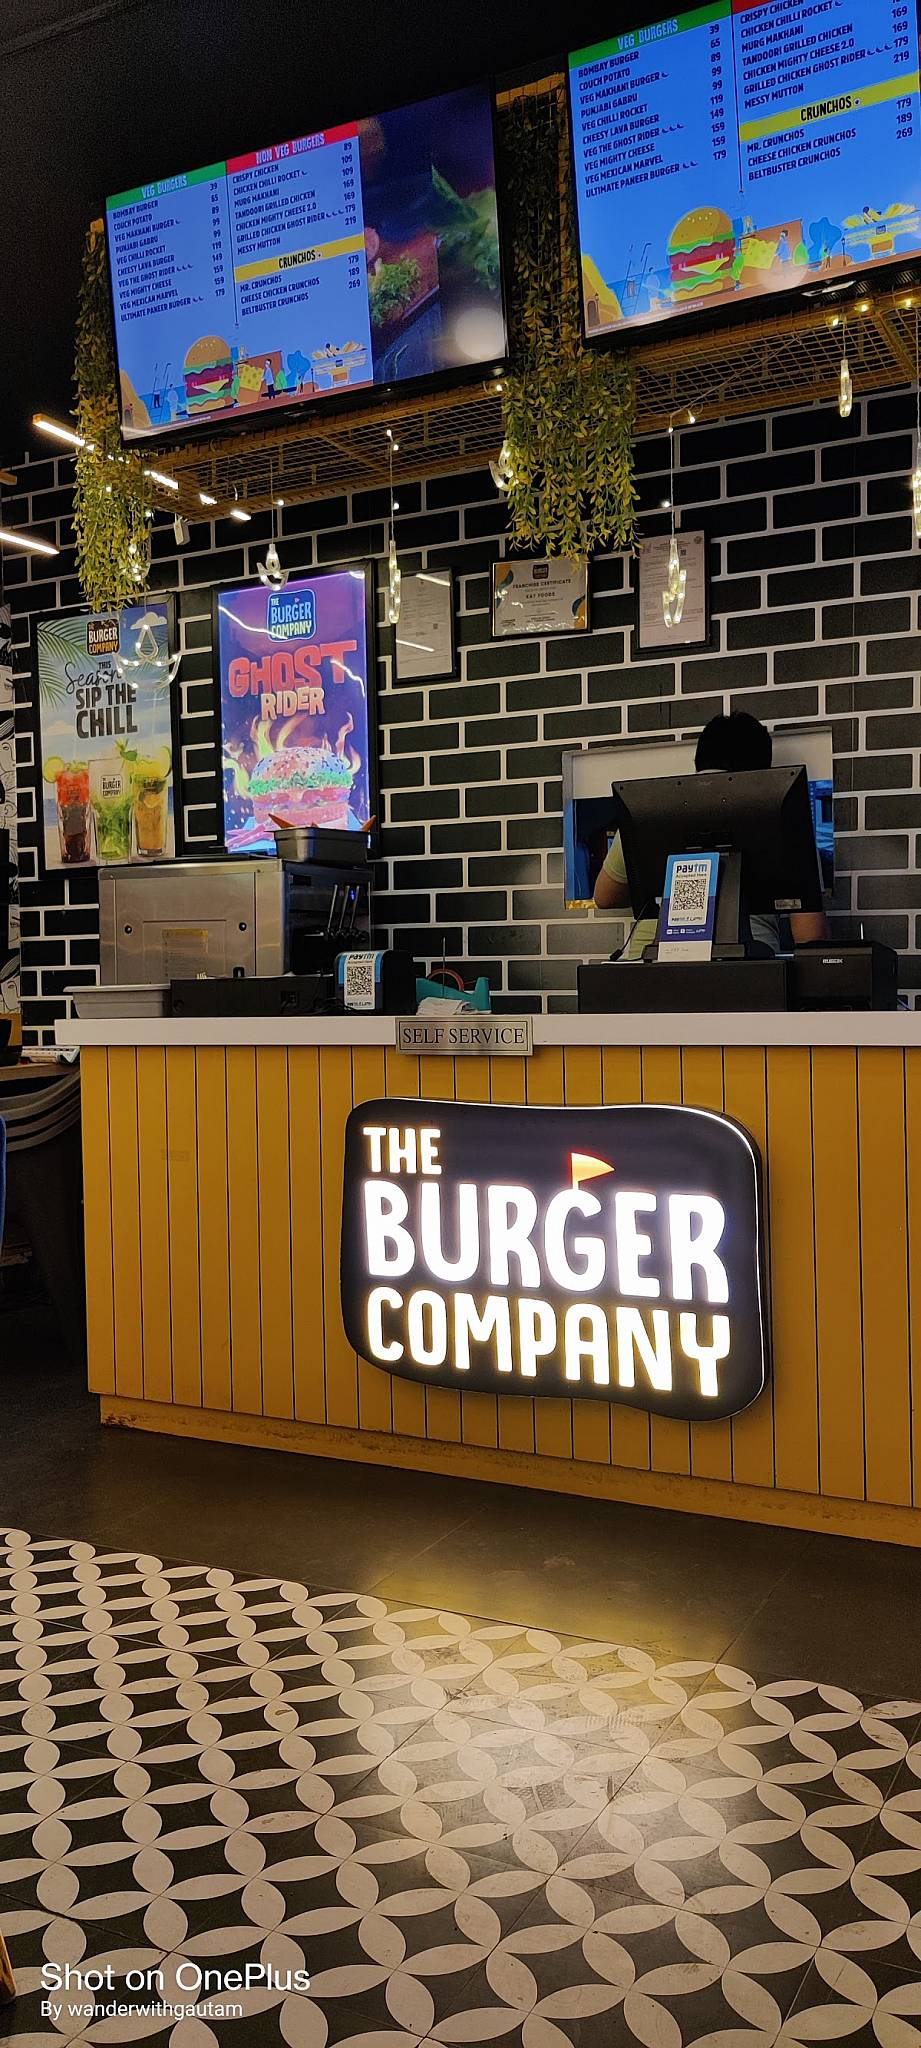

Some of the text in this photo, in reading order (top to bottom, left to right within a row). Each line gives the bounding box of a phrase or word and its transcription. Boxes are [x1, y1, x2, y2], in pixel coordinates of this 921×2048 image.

[740, 8, 768, 24] CRISPY
[741, 1, 833, 38] CHICKEN CHILLI ROCKET
[892, 6, 907, 18] 169
[618, 19, 678, 49] VEG BURGERS
[709, 24, 719, 34] 39
[892, 21, 908, 33] 169
[710, 39, 720, 48] 65
[742, 25, 803, 52] MURG MAKHANI
[742, 24, 853, 66] TANDOORI GRILLED CHICKEN
[893, 36, 908, 48] 179
[578, 51, 639, 77] BOMBAY BURGER
[711, 53, 720, 62] 89
[743, 38, 854, 81] CHICKEN MIGHTY CHEESE 2.0
[893, 51, 909, 64] 219
[712, 66, 721, 76] 99
[744, 49, 866, 94] GRILLED CHICKEN GHOST RIDER
[579, 68, 630, 91] COUCH POTATO
[712, 80, 722, 90] 99
[580, 72, 659, 104] VEG MAKHANI BURGER
[744, 83, 804, 109] MESSY MUTTON
[581, 93, 637, 118] PUNJABI GABRU
[710, 94, 723, 104] 119
[896, 98, 911, 110] 179
[710, 108, 724, 118] 149
[801, 96, 852, 121] CRUNCHOS
[582, 104, 648, 131] VEG CHILLI ROCKET
[896, 113, 912, 124] 189
[582, 114, 659, 144] CHEESY LAVA BURGER
[712, 122, 724, 133] 159
[896, 127, 912, 139] 269
[344, 142, 352, 151] 89
[584, 128, 659, 158] VEG THE GHOST RIDER
[712, 136, 725, 146] 159
[747, 129, 804, 153] MR. CRUNCHOS
[748, 128, 856, 166] CHEESE CHICKEN CRUNCHOS
[341, 154, 352, 164] 109
[584, 143, 655, 171] VEG MIGHTY CHEESE
[713, 150, 726, 160] 179
[342, 167, 353, 176] 109
[585, 154, 663, 184] VEG MEXICAN MARVEL
[749, 147, 840, 181] BELTBUSTER CRUNCHOS
[233, 164, 279, 184] CRISPY CHICKEN
[586, 163, 680, 198] ULTIMATE PANEER BURGER
[210, 183, 217, 191] 39
[234, 170, 300, 196] CHICKEN CHILLI ROCKET
[343, 179, 354, 188] 169
[344, 192, 355, 200] 169
[113, 200, 158, 219] BOMBAY BURGER
[236, 202, 316, 231] CHICKEN MIGHTY CHEESE 2.0
[345, 204, 356, 213] 179
[236, 211, 325, 243] GRILLED CHICKEN GHOST RIDER
[345, 216, 356, 225] 219
[238, 236, 281, 255] MESSY MUTTON
[212, 254, 222, 262] 149
[279, 250, 316, 268] CRUNCHOS
[348, 255, 359, 264] 179
[214, 265, 223, 273] 159
[348, 267, 360, 276] 189
[214, 277, 224, 285] 159
[240, 275, 282, 292] MR. CRUNCHOS
[348, 280, 360, 289] 269
[241, 277, 320, 304] CHEESE CHICKEN CRUNCHOS
[271, 598, 279, 606] THE
[272, 602, 311, 624] BURGER
[89, 627, 118, 643] BURGER
[272, 620, 312, 638] COMPANY
[89, 641, 118, 654] COMPANY
[99, 661, 111, 669] THIS
[228, 640, 357, 697] GHOST
[76, 683, 136, 710] SIP THE
[261, 686, 325, 720] RIDER
[76, 705, 138, 738] CHILL
[103, 780, 120, 790] BURGER
[677, 864, 707, 873] paytm
[402, 1028, 524, 1044] SELF SERVICE
[363, 1126, 442, 1175] THE
[363, 1180, 730, 1303] BURGER
[367, 1286, 730, 1397] COMPANY
